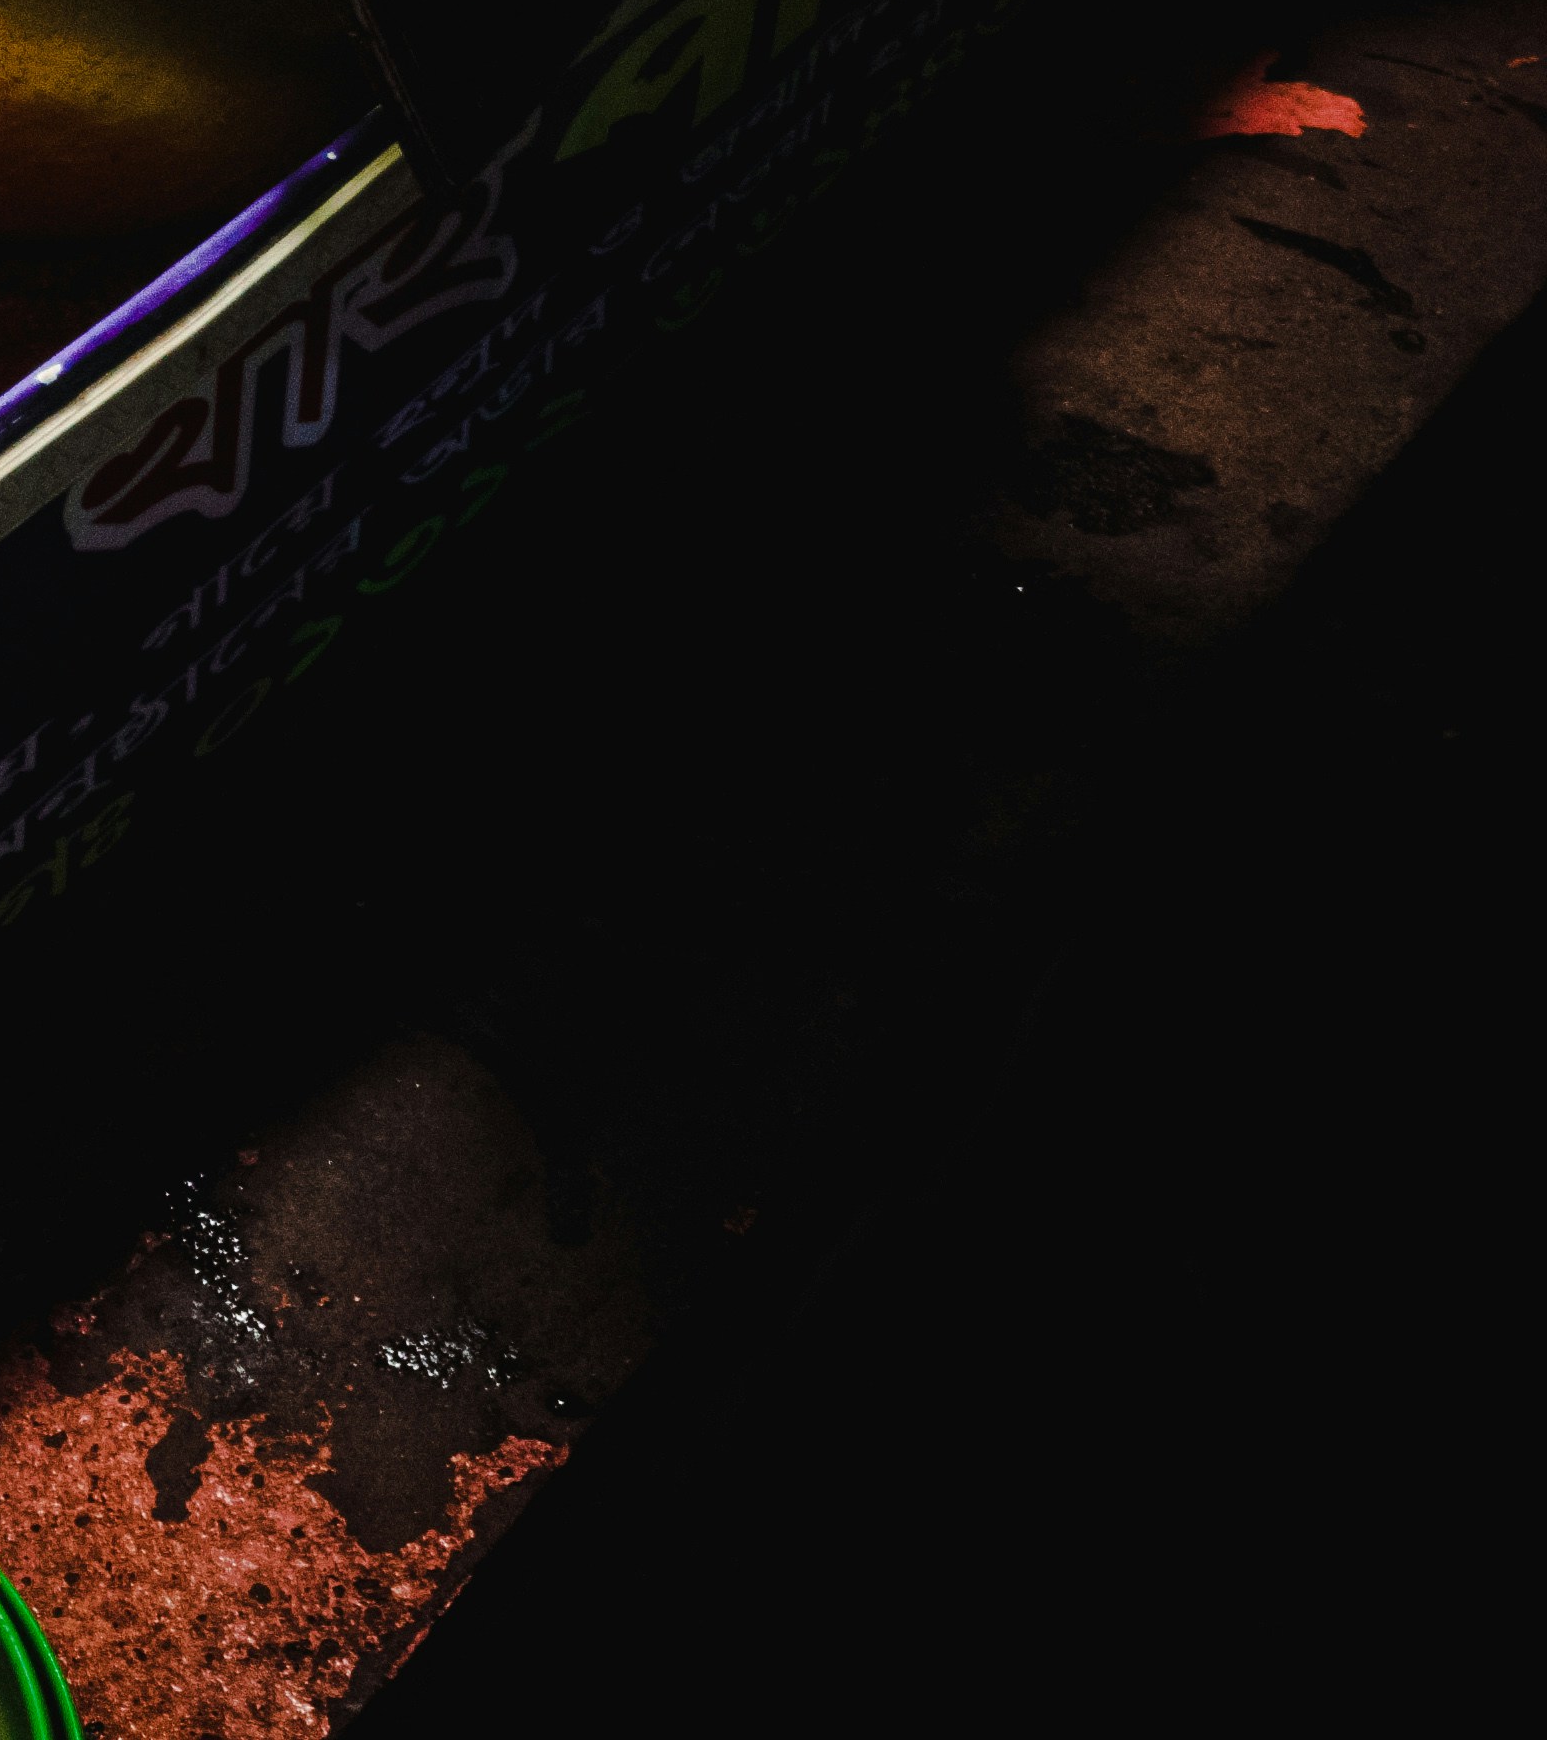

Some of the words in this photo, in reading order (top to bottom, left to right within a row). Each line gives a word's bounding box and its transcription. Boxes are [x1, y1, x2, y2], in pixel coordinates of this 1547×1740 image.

[141, 469, 337, 650] গায়ে
[374, 291, 545, 449] হলুদ
[588, 203, 642, 256] ও
[399, 293, 605, 484] অর্ডার
